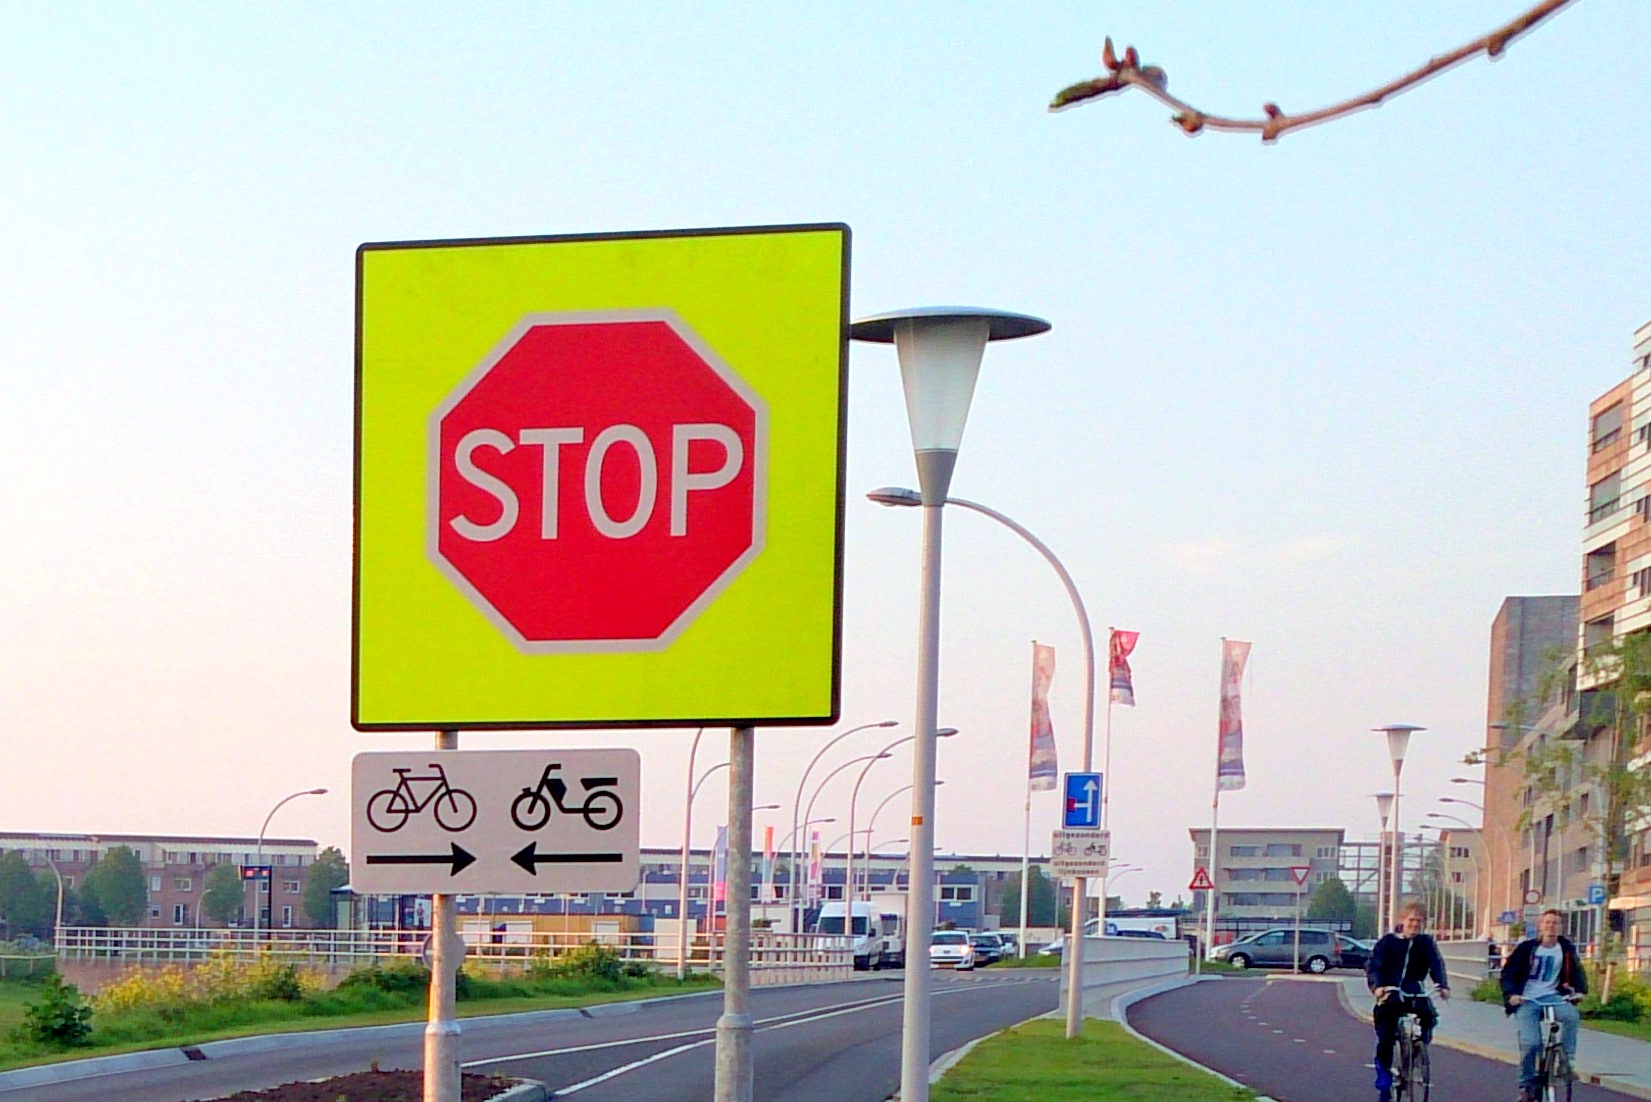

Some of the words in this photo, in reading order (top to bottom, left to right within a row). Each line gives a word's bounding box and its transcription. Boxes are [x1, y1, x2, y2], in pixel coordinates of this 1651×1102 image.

[449, 423, 744, 542] STOP
[1053, 830, 1109, 839] uitgezonderd
[1592, 887, 1604, 902] P
